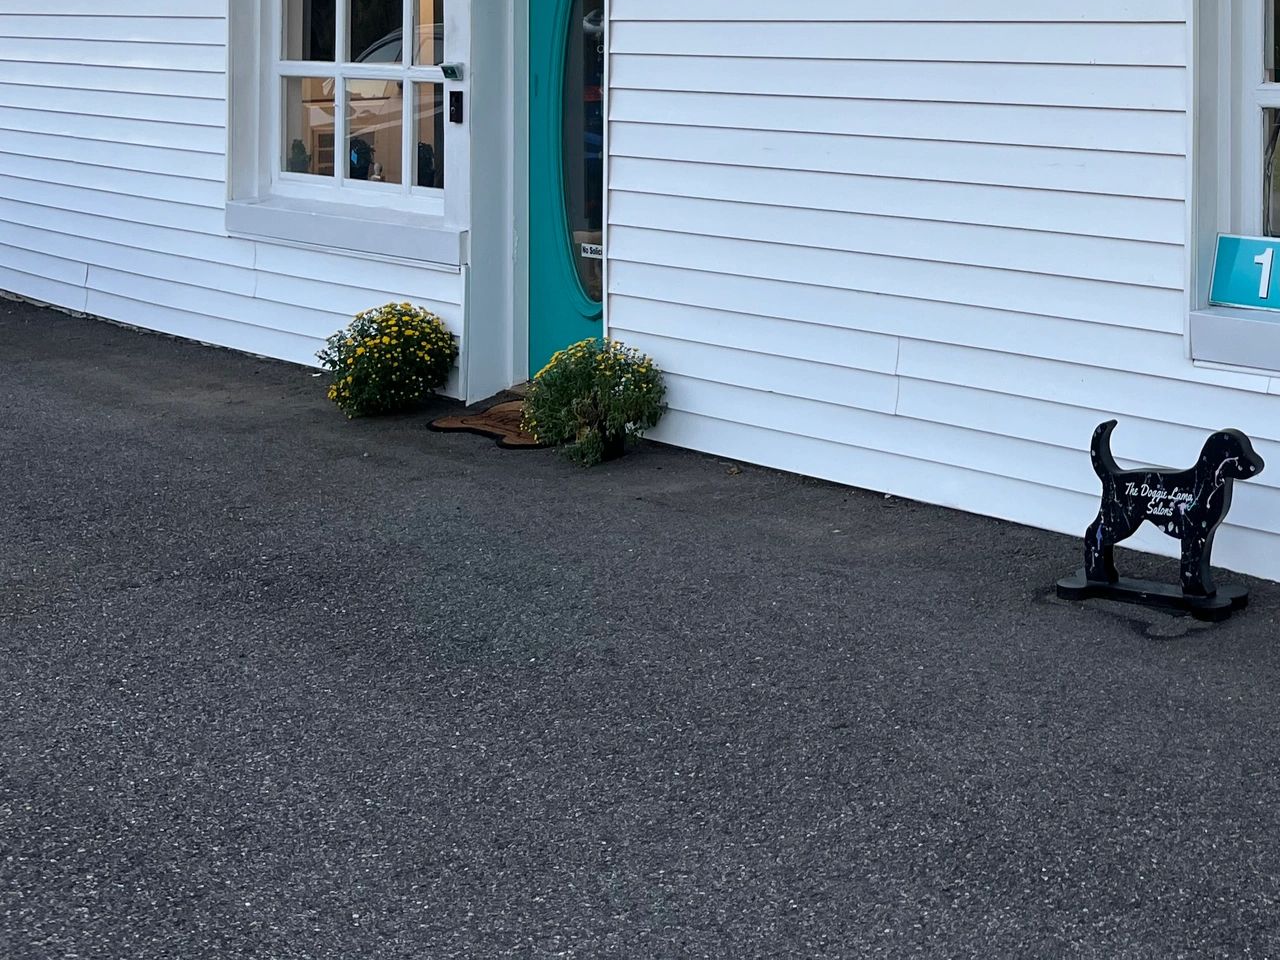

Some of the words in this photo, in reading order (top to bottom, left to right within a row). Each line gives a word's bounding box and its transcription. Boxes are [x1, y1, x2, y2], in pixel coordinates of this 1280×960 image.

[1125, 482, 1139, 496] The
[1140, 483, 1168, 502] Doggie
[1167, 486, 1194, 501] Lama
[1146, 501, 1174, 516] Salons
